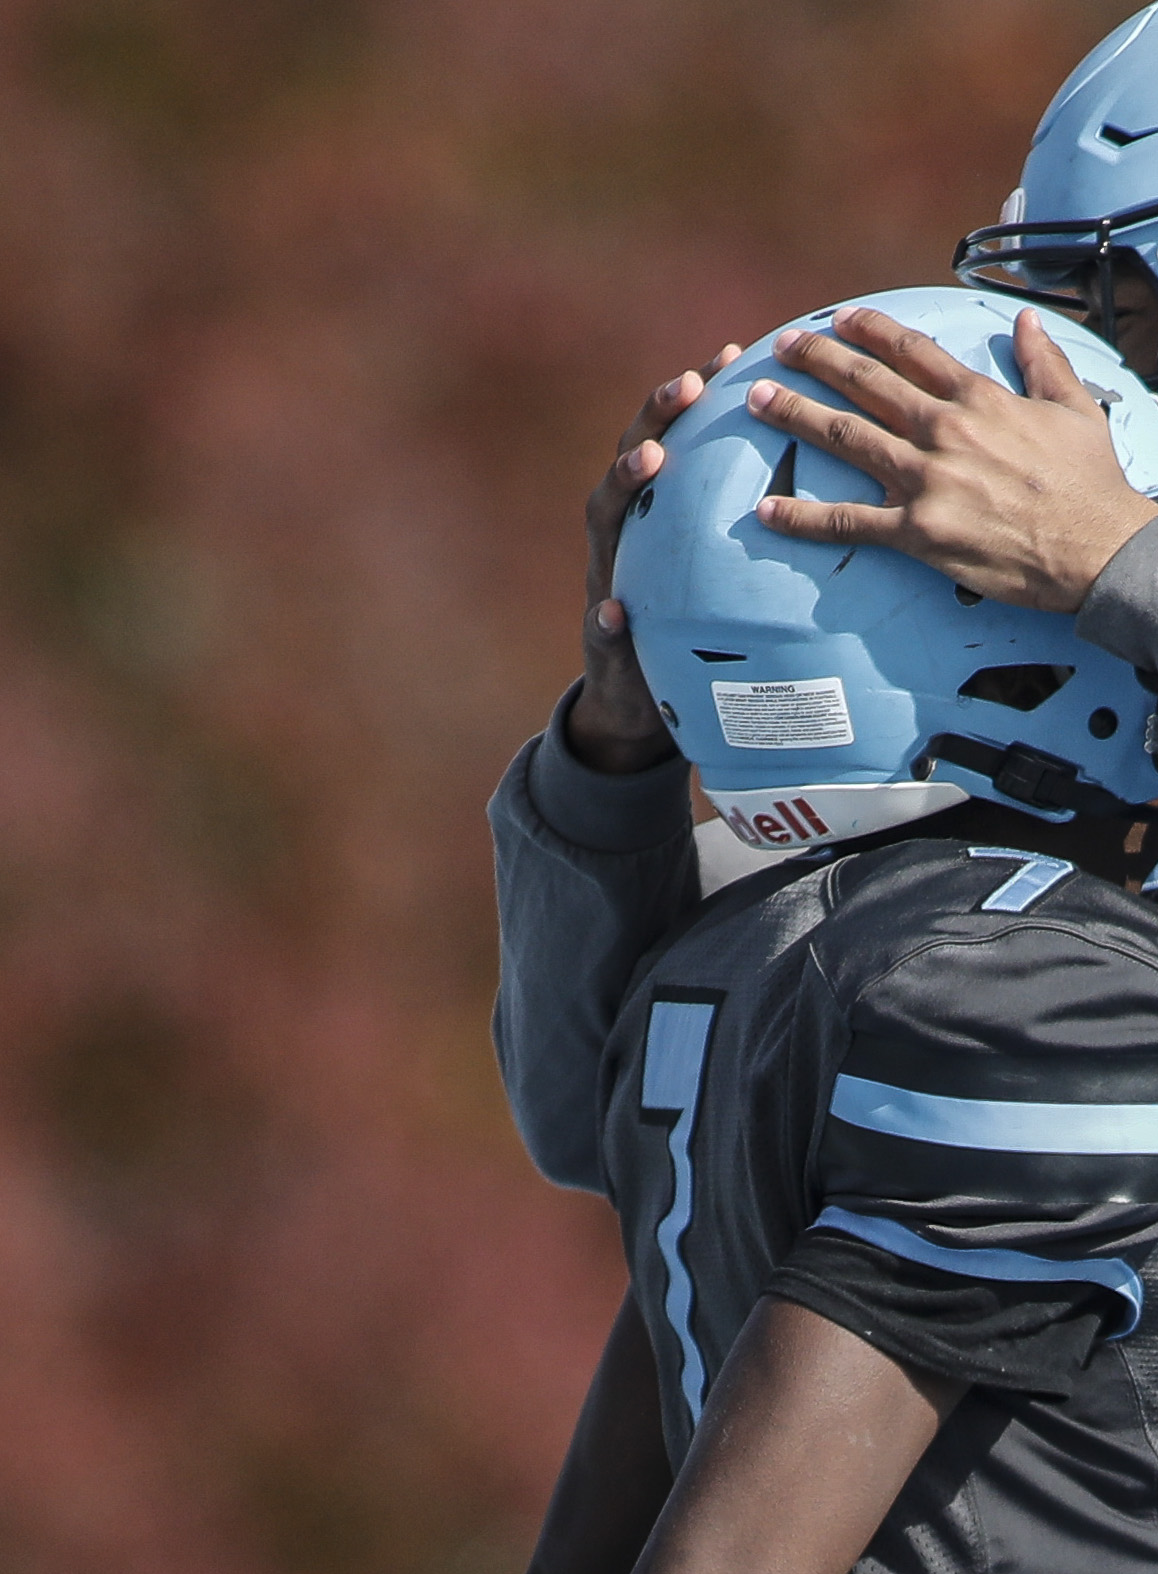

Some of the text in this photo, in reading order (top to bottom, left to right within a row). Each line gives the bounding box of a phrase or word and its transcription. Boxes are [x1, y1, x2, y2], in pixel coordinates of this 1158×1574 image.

[751, 685, 796, 693] WARNING
[967, 846, 1074, 913] 7
[641, 1001, 716, 1428] 7
